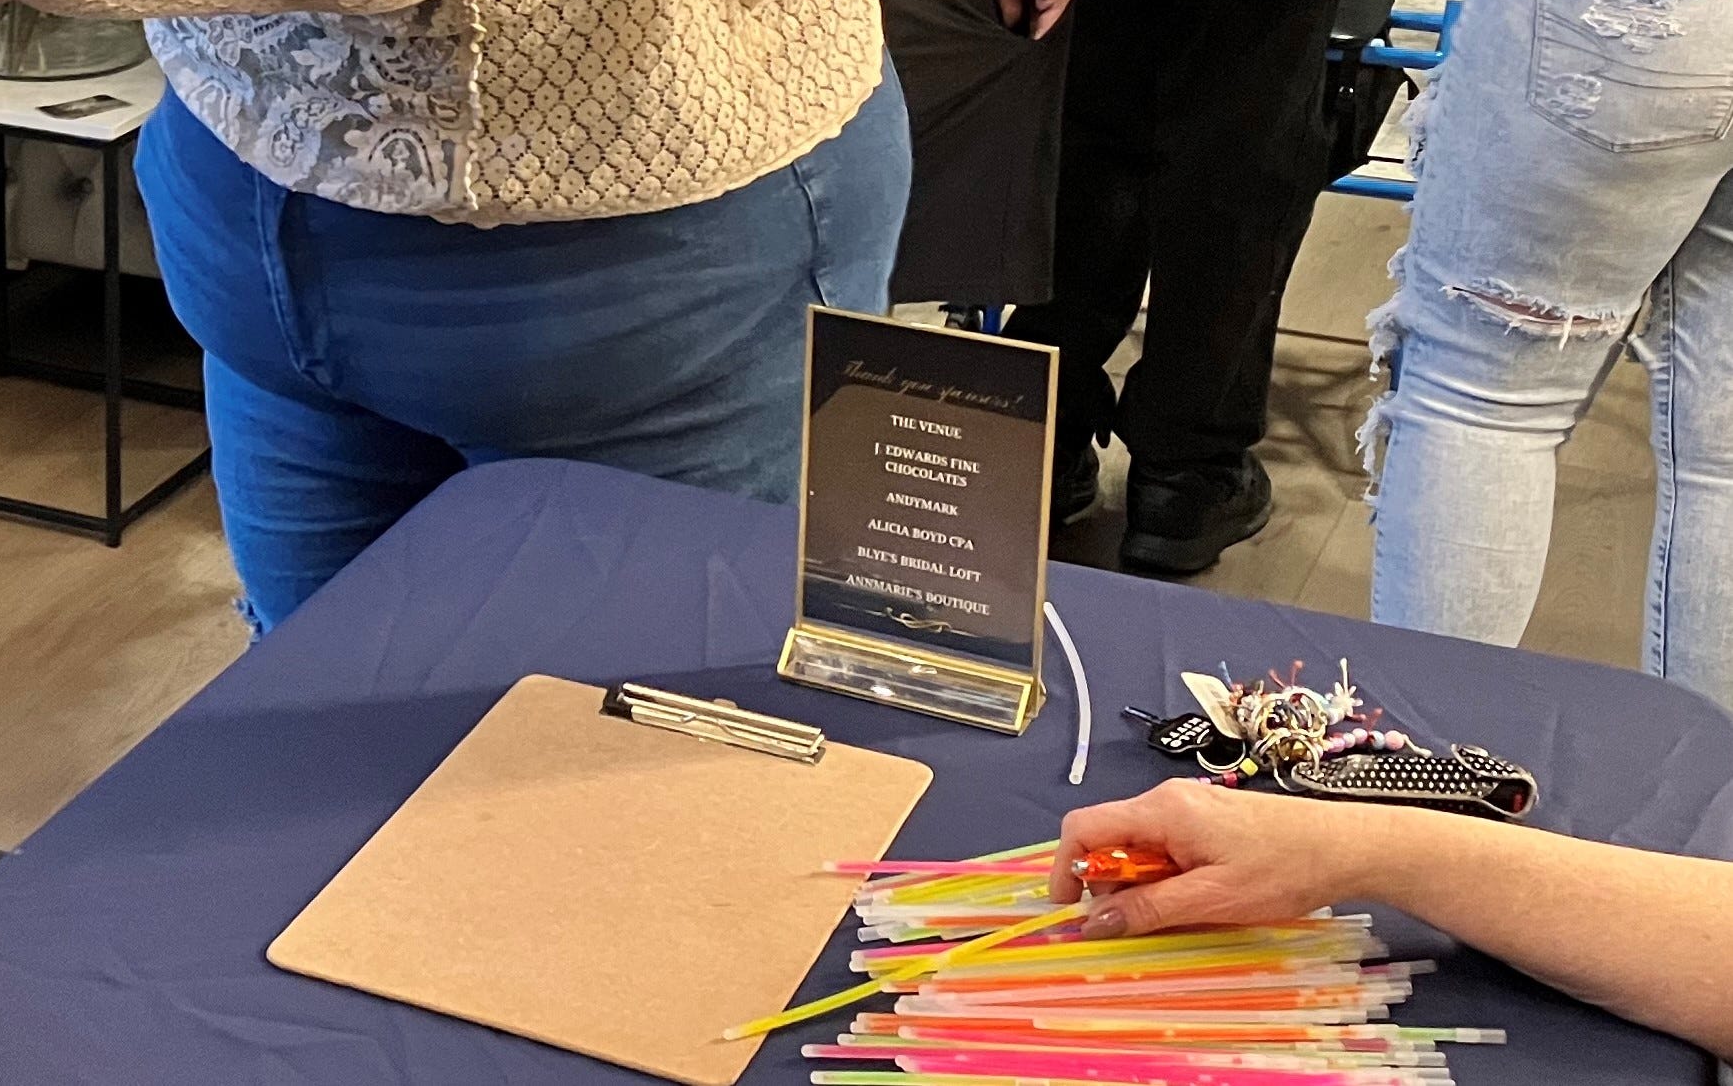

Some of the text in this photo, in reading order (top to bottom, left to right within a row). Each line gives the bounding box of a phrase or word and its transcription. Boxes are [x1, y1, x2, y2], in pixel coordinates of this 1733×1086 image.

[841, 360, 897, 384] Thank
[890, 414, 963, 440] THE VENUE
[885, 444, 948, 467] EDWARDS
[950, 458, 981, 474] FINE
[884, 461, 968, 488] CHOCOLATES
[886, 492, 959, 516] ANDYMARK
[868, 518, 975, 551] ALICIA BOYD CPA
[857, 545, 982, 583] BLYE'S BRIDAL LOFT
[845, 573, 991, 616] ANNMARIE'S BOUTIQUE
[1160, 717, 1202, 745] KITTY
[1170, 721, 1212, 748] HELLO
